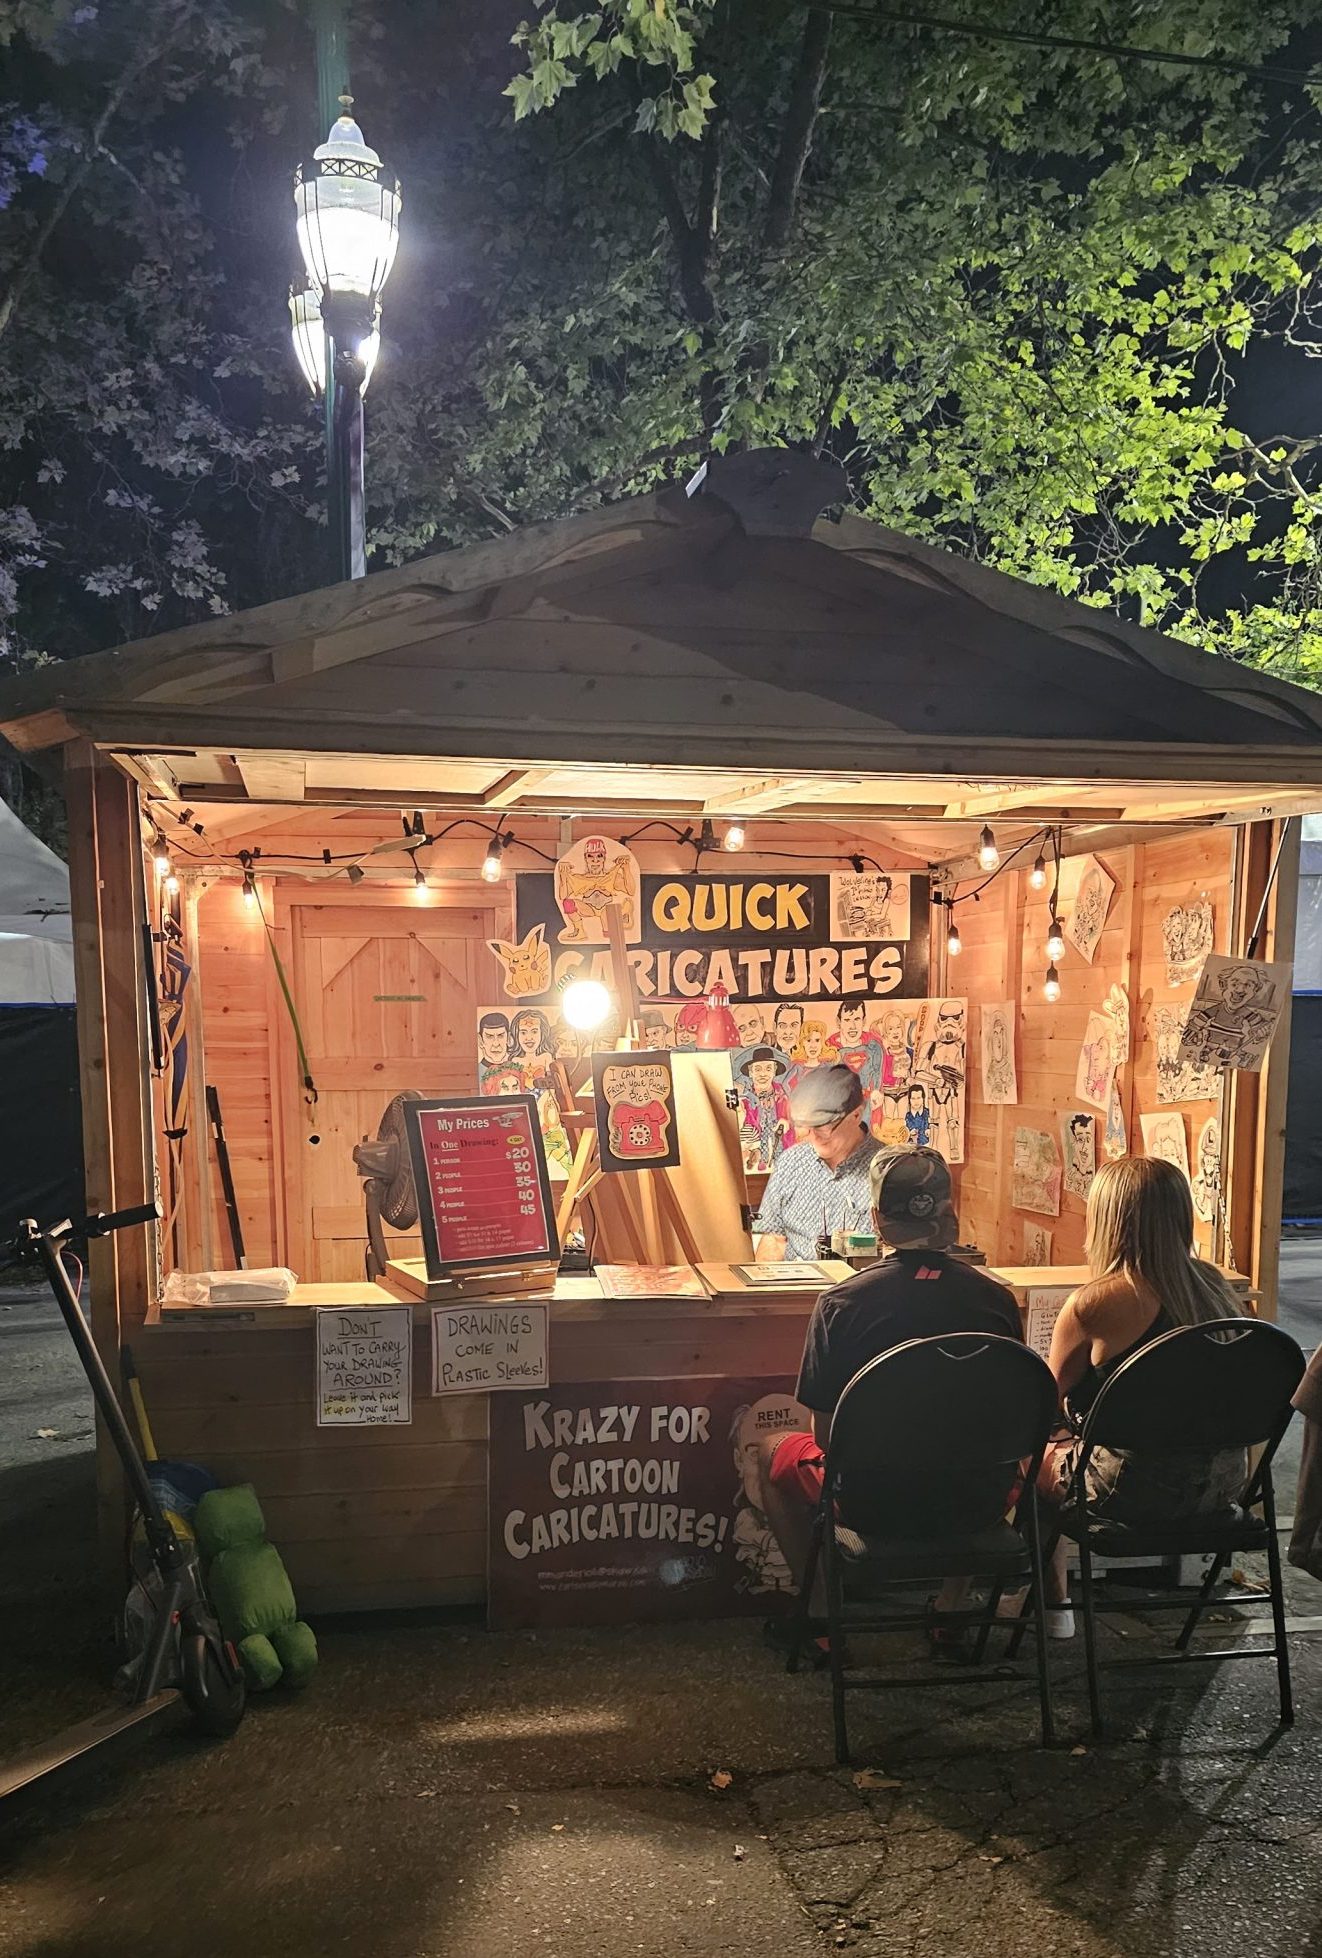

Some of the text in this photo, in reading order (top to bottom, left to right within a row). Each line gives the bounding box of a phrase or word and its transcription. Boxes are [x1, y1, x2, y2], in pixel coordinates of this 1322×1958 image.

[652, 883, 810, 932] QUICK
[621, 1068, 636, 1080] CAN
[640, 1067, 663, 1078] DRAW
[606, 1082, 627, 1096] FROM
[437, 1118, 490, 1132] My Prices
[429, 1137, 500, 1152] In One Drawing:
[505, 1146, 530, 1160] $20
[435, 1171, 441, 1180] 2
[437, 1186, 444, 1194] 3
[518, 1189, 535, 1200] 40
[440, 1200, 446, 1208] 4
[520, 1204, 536, 1215] 45
[442, 1215, 448, 1224] 5
[338, 1316, 382, 1336] DON'T
[322, 1341, 350, 1355] WANT
[455, 1340, 519, 1358] COME IN
[333, 1368, 401, 1387] AROUND?
[350, 1392, 358, 1402] it
[361, 1391, 377, 1401] and
[334, 1406, 343, 1416] up
[359, 1405, 378, 1418] your
[758, 1408, 790, 1422] RENT
[523, 1401, 711, 1451] KRAZY FOR
[755, 1419, 800, 1430] THIS SPACE
[550, 1452, 681, 1499] CARTOON
[504, 1502, 729, 1560] CARICATURES!
